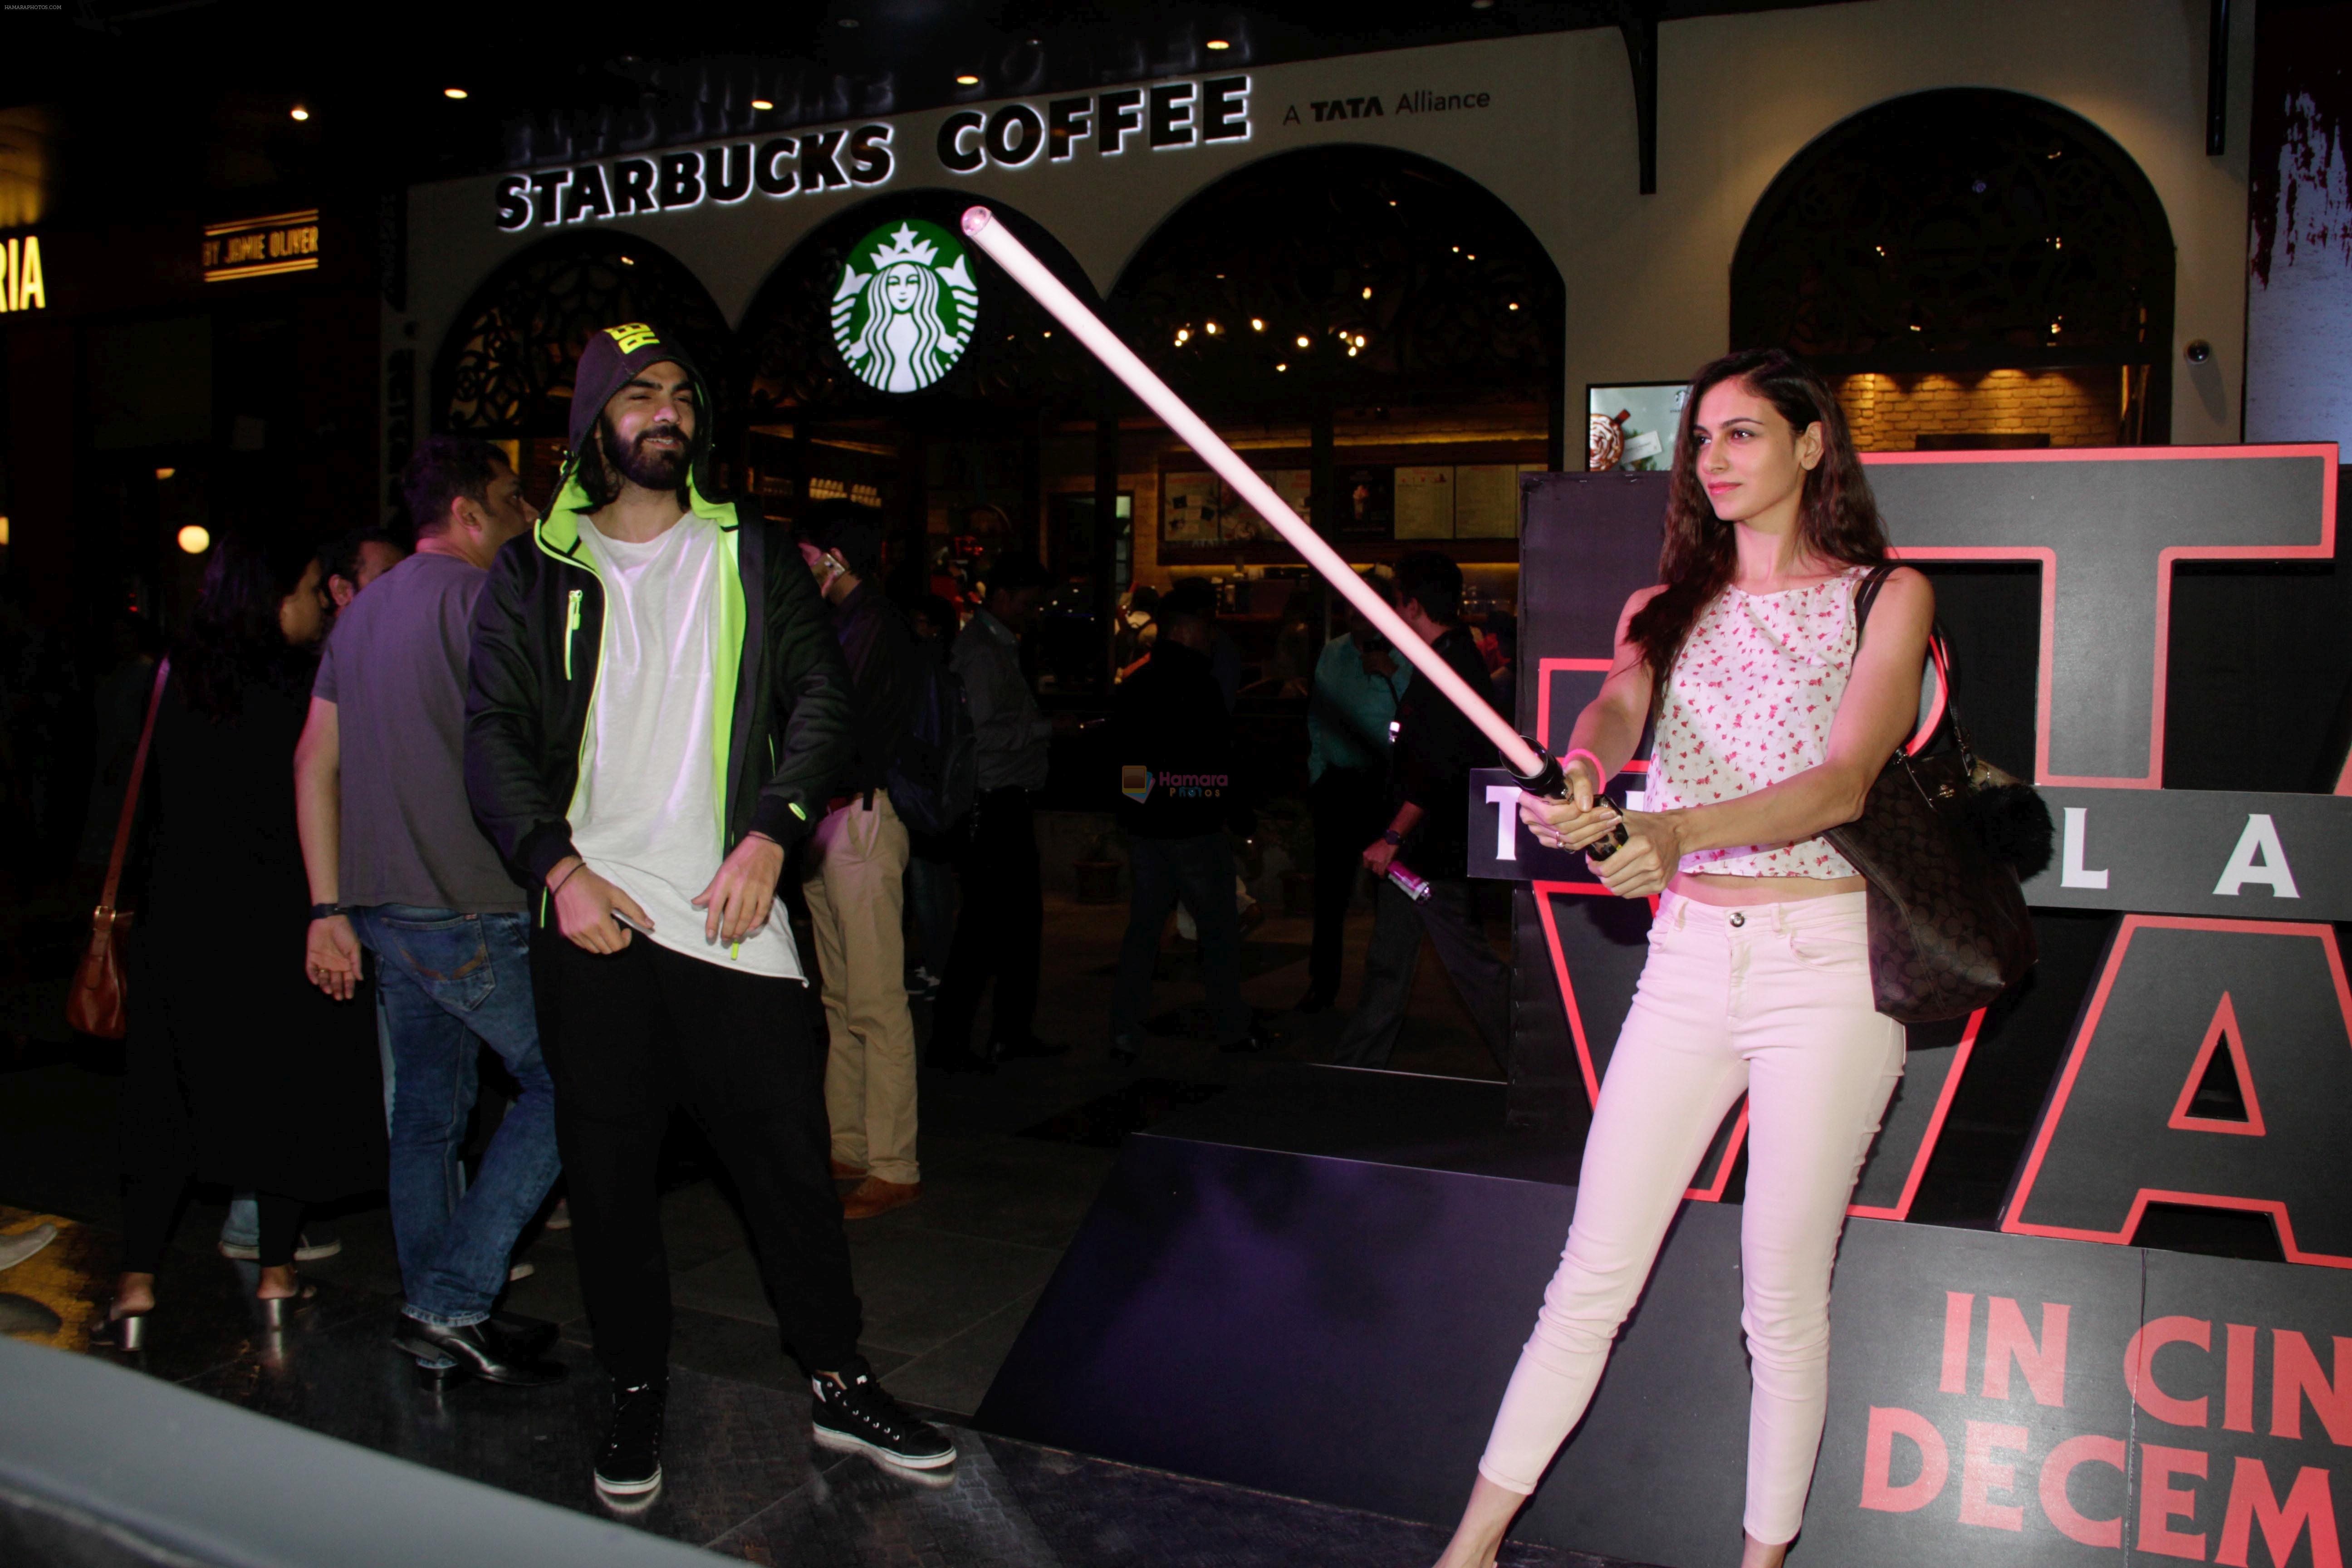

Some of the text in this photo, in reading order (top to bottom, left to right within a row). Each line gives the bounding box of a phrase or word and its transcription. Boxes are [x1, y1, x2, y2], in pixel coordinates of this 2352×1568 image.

[495, 75, 1251, 232] STARBUCKS COFFEE
[1283, 89, 1490, 126] A TATA Alliance
[1938, 1290, 2352, 1447] IN CIN
[1858, 1405, 2344, 1568] DECEM
